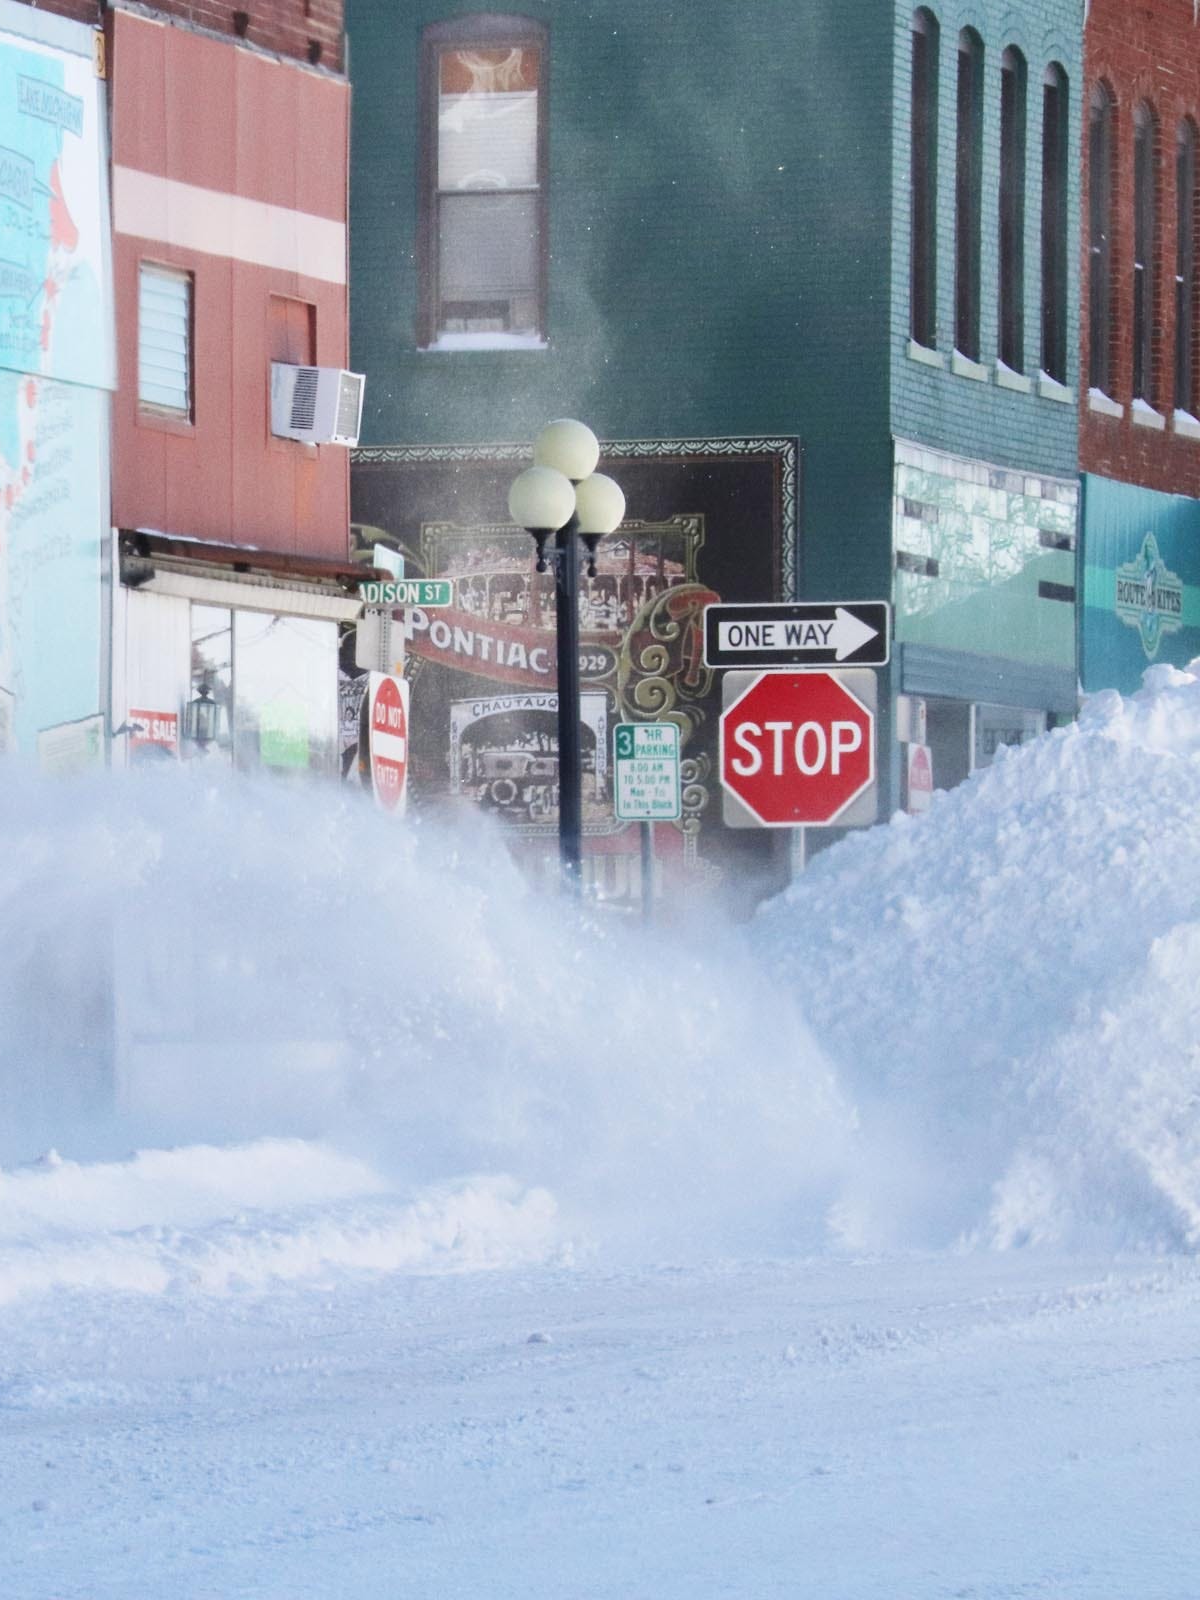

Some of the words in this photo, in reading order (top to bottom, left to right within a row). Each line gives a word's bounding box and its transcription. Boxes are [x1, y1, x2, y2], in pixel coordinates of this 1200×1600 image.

[359, 581, 420, 605] ADISON
[424, 583, 442, 601] ST
[404, 606, 549, 674] PONTIAC
[727, 625, 775, 647] ONE
[784, 623, 834, 646] WAY
[578, 655, 607, 671] 929
[375, 702, 386, 724] DO
[387, 705, 402, 728] NOT
[472, 698, 558, 717] CHAUTAUQ
[153, 719, 177, 743] SALE
[618, 731, 632, 755] 3
[647, 728, 663, 741] HR
[636, 744, 675, 756] PARKING
[731, 721, 862, 777] STOP
[652, 763, 664, 772] AM
